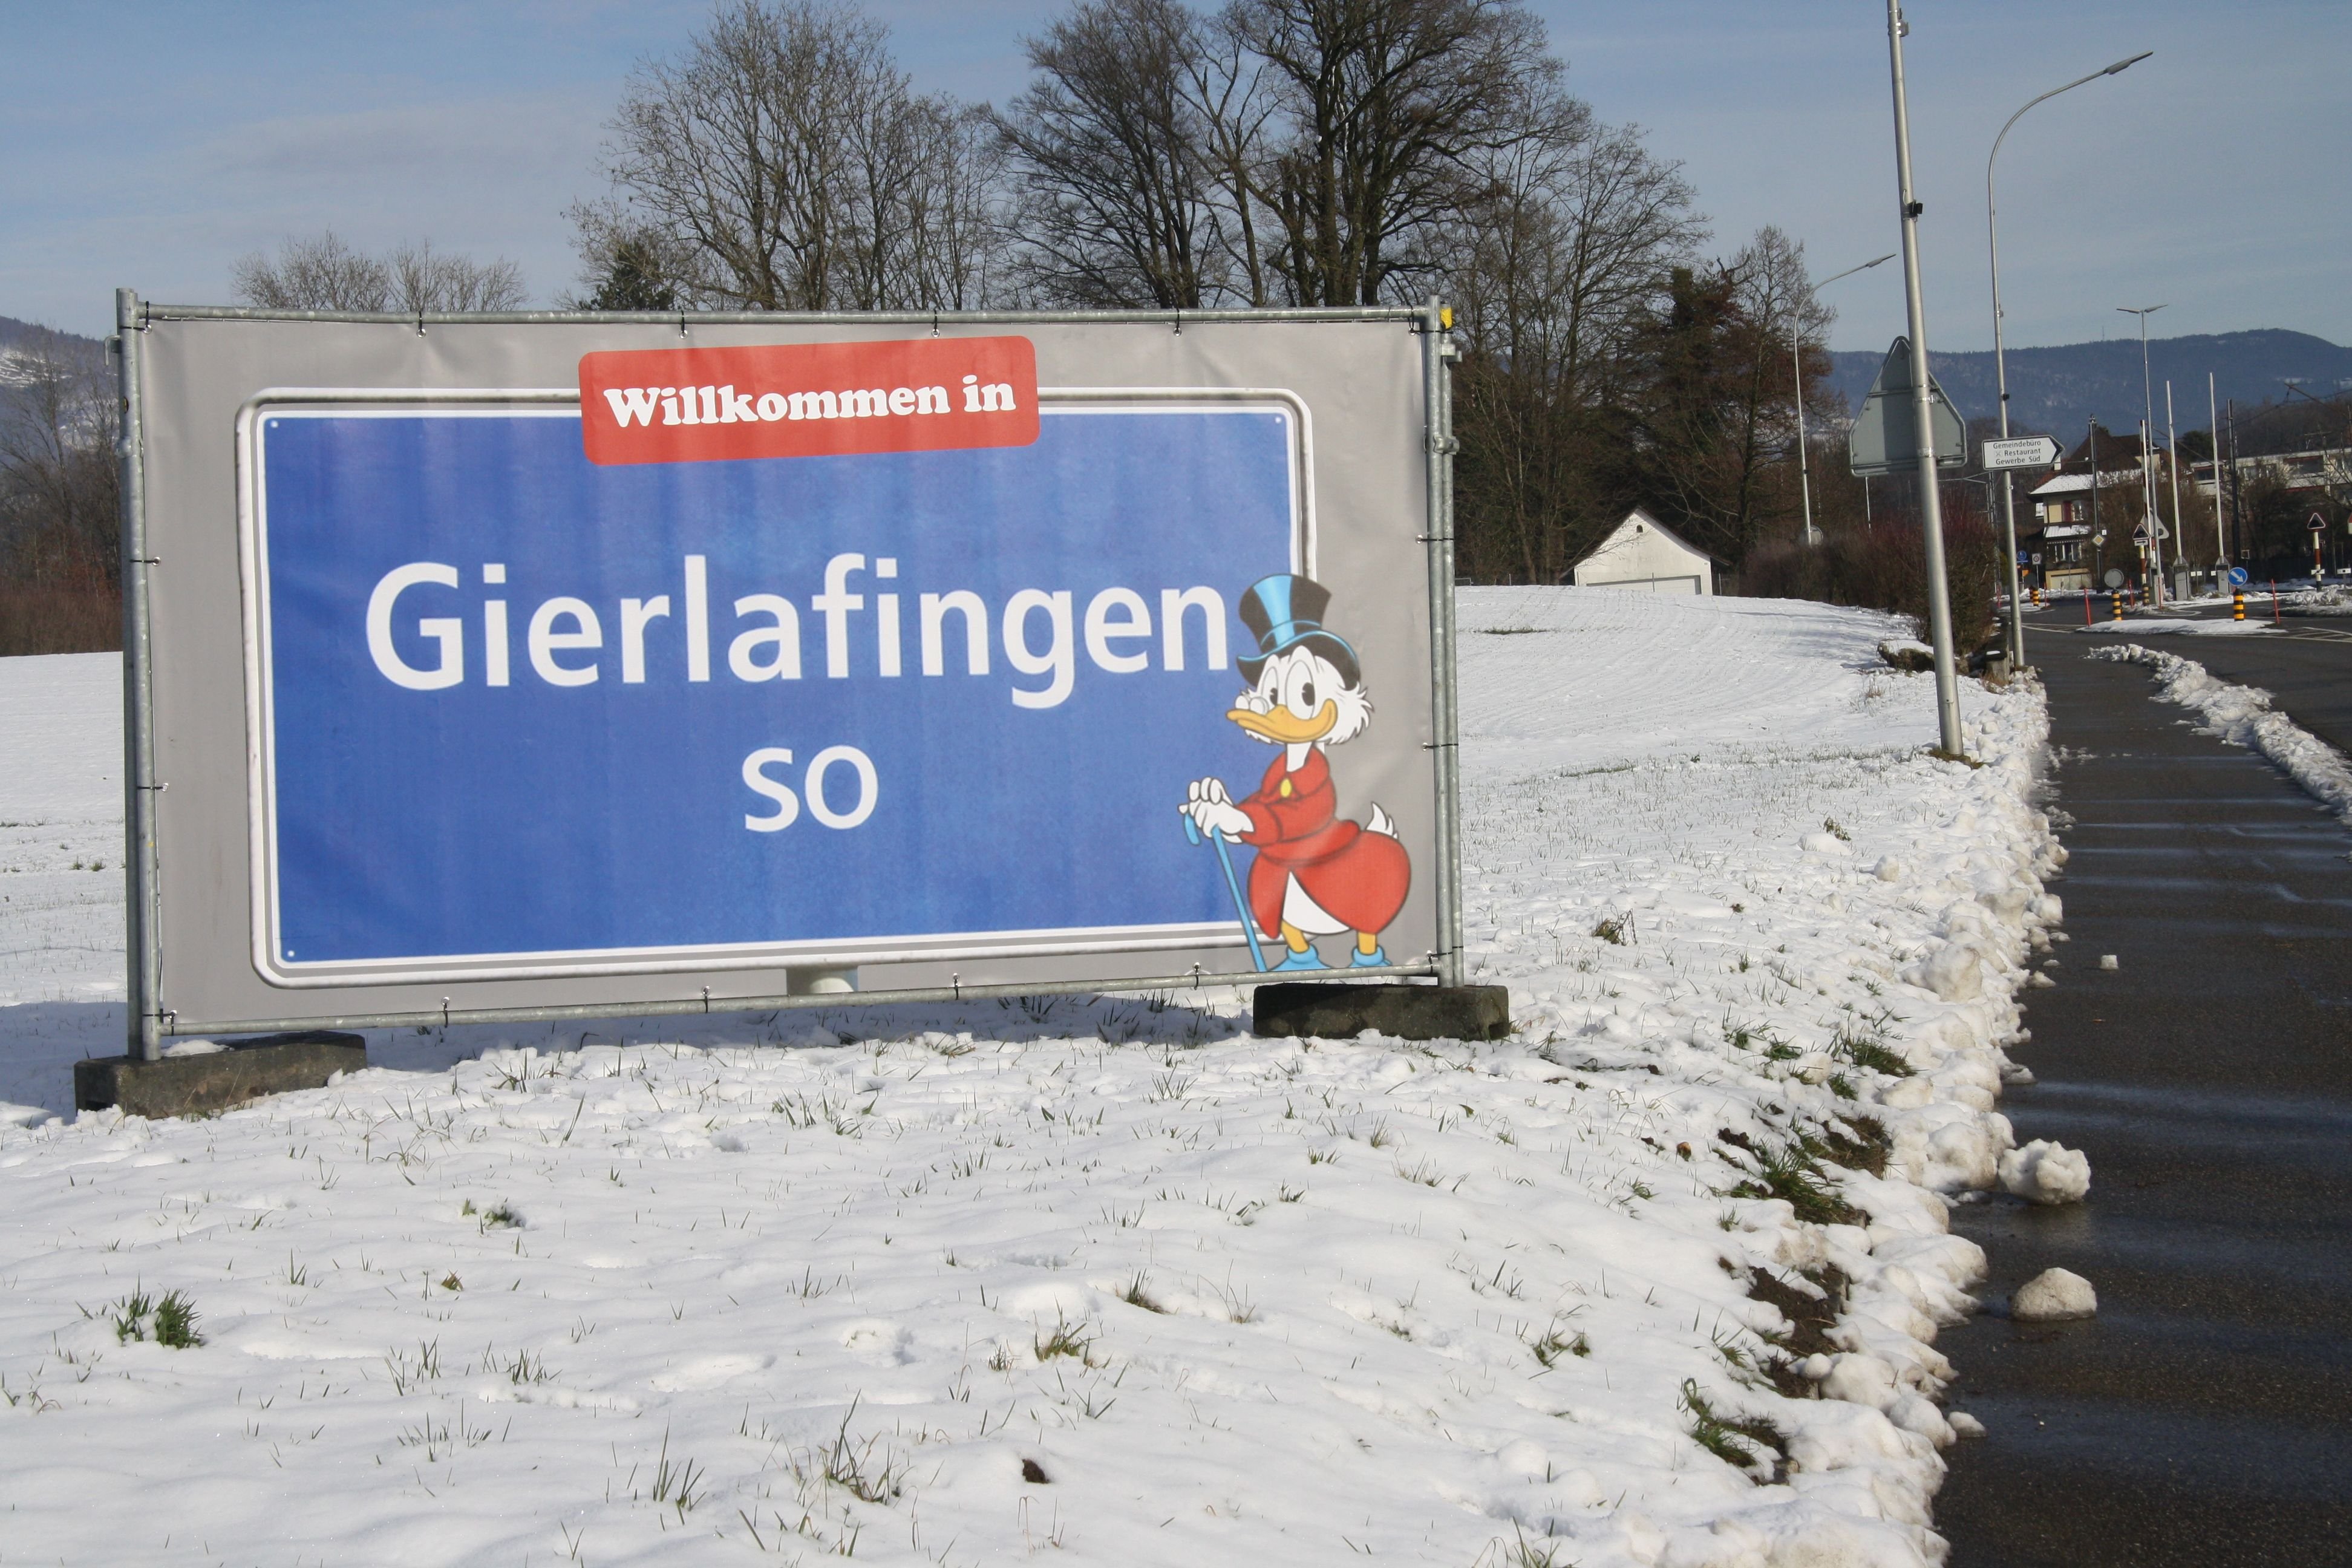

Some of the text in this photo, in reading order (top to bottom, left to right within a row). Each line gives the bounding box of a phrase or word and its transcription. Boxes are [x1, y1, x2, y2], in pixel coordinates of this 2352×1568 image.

[603, 375, 1016, 427] Willkommen in
[1993, 440, 2041, 449] Gemeindebüro
[367, 553, 1229, 710] Gierlafingen
